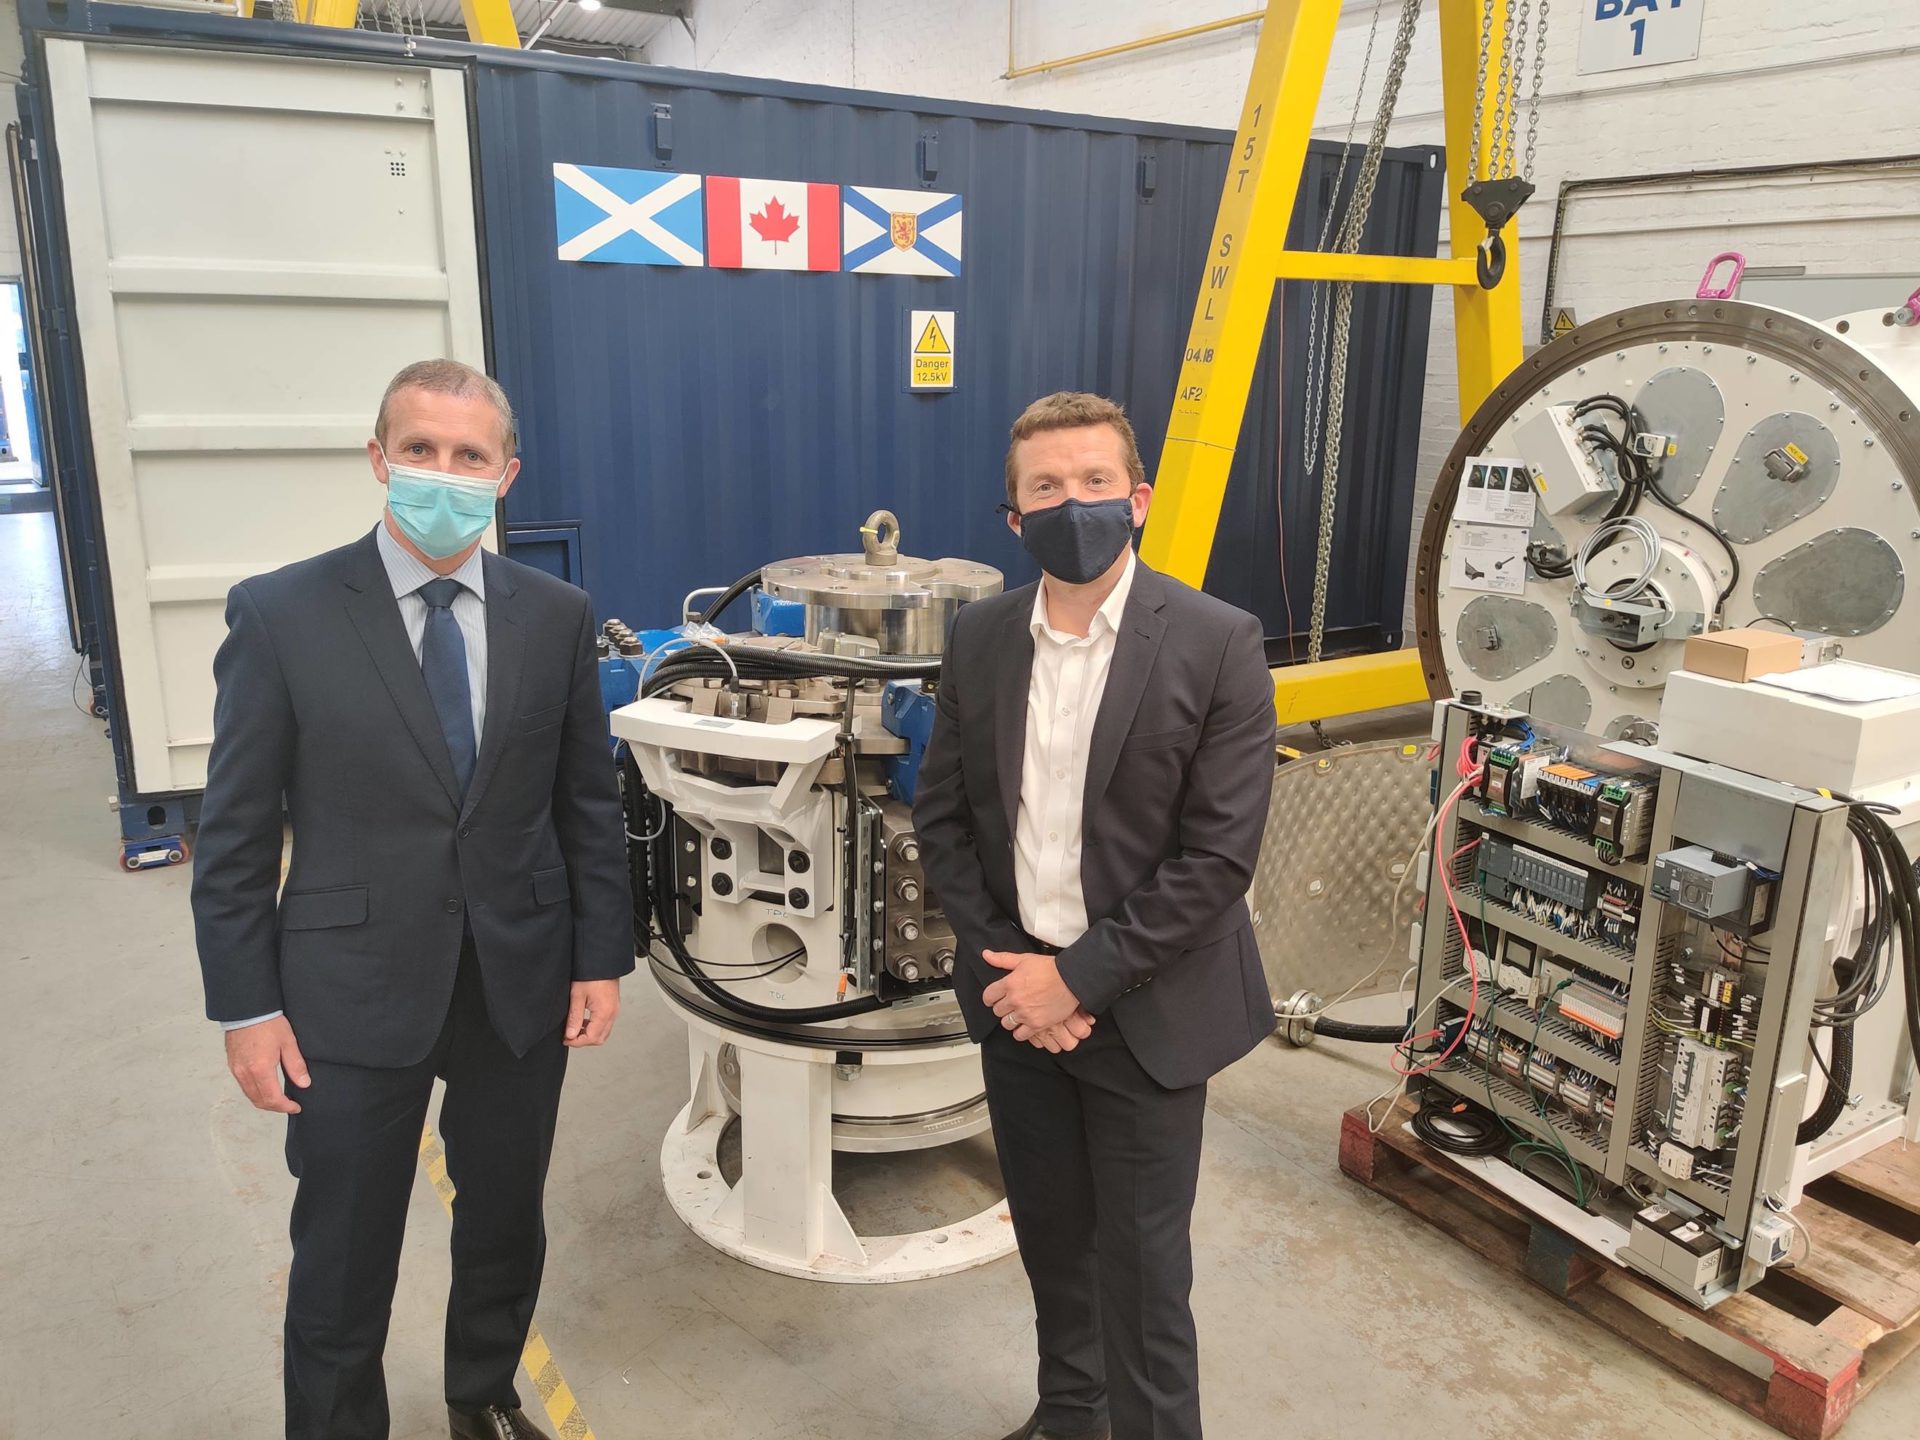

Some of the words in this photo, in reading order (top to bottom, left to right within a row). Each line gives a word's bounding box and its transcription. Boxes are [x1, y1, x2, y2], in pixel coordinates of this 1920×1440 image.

[1595, 0, 1681, 21] BA
[1630, 18, 1646, 56] 1
[915, 359, 949, 370] Danger
[917, 373, 947, 382] 12.5kV
[1180, 386, 1203, 401] AF2
